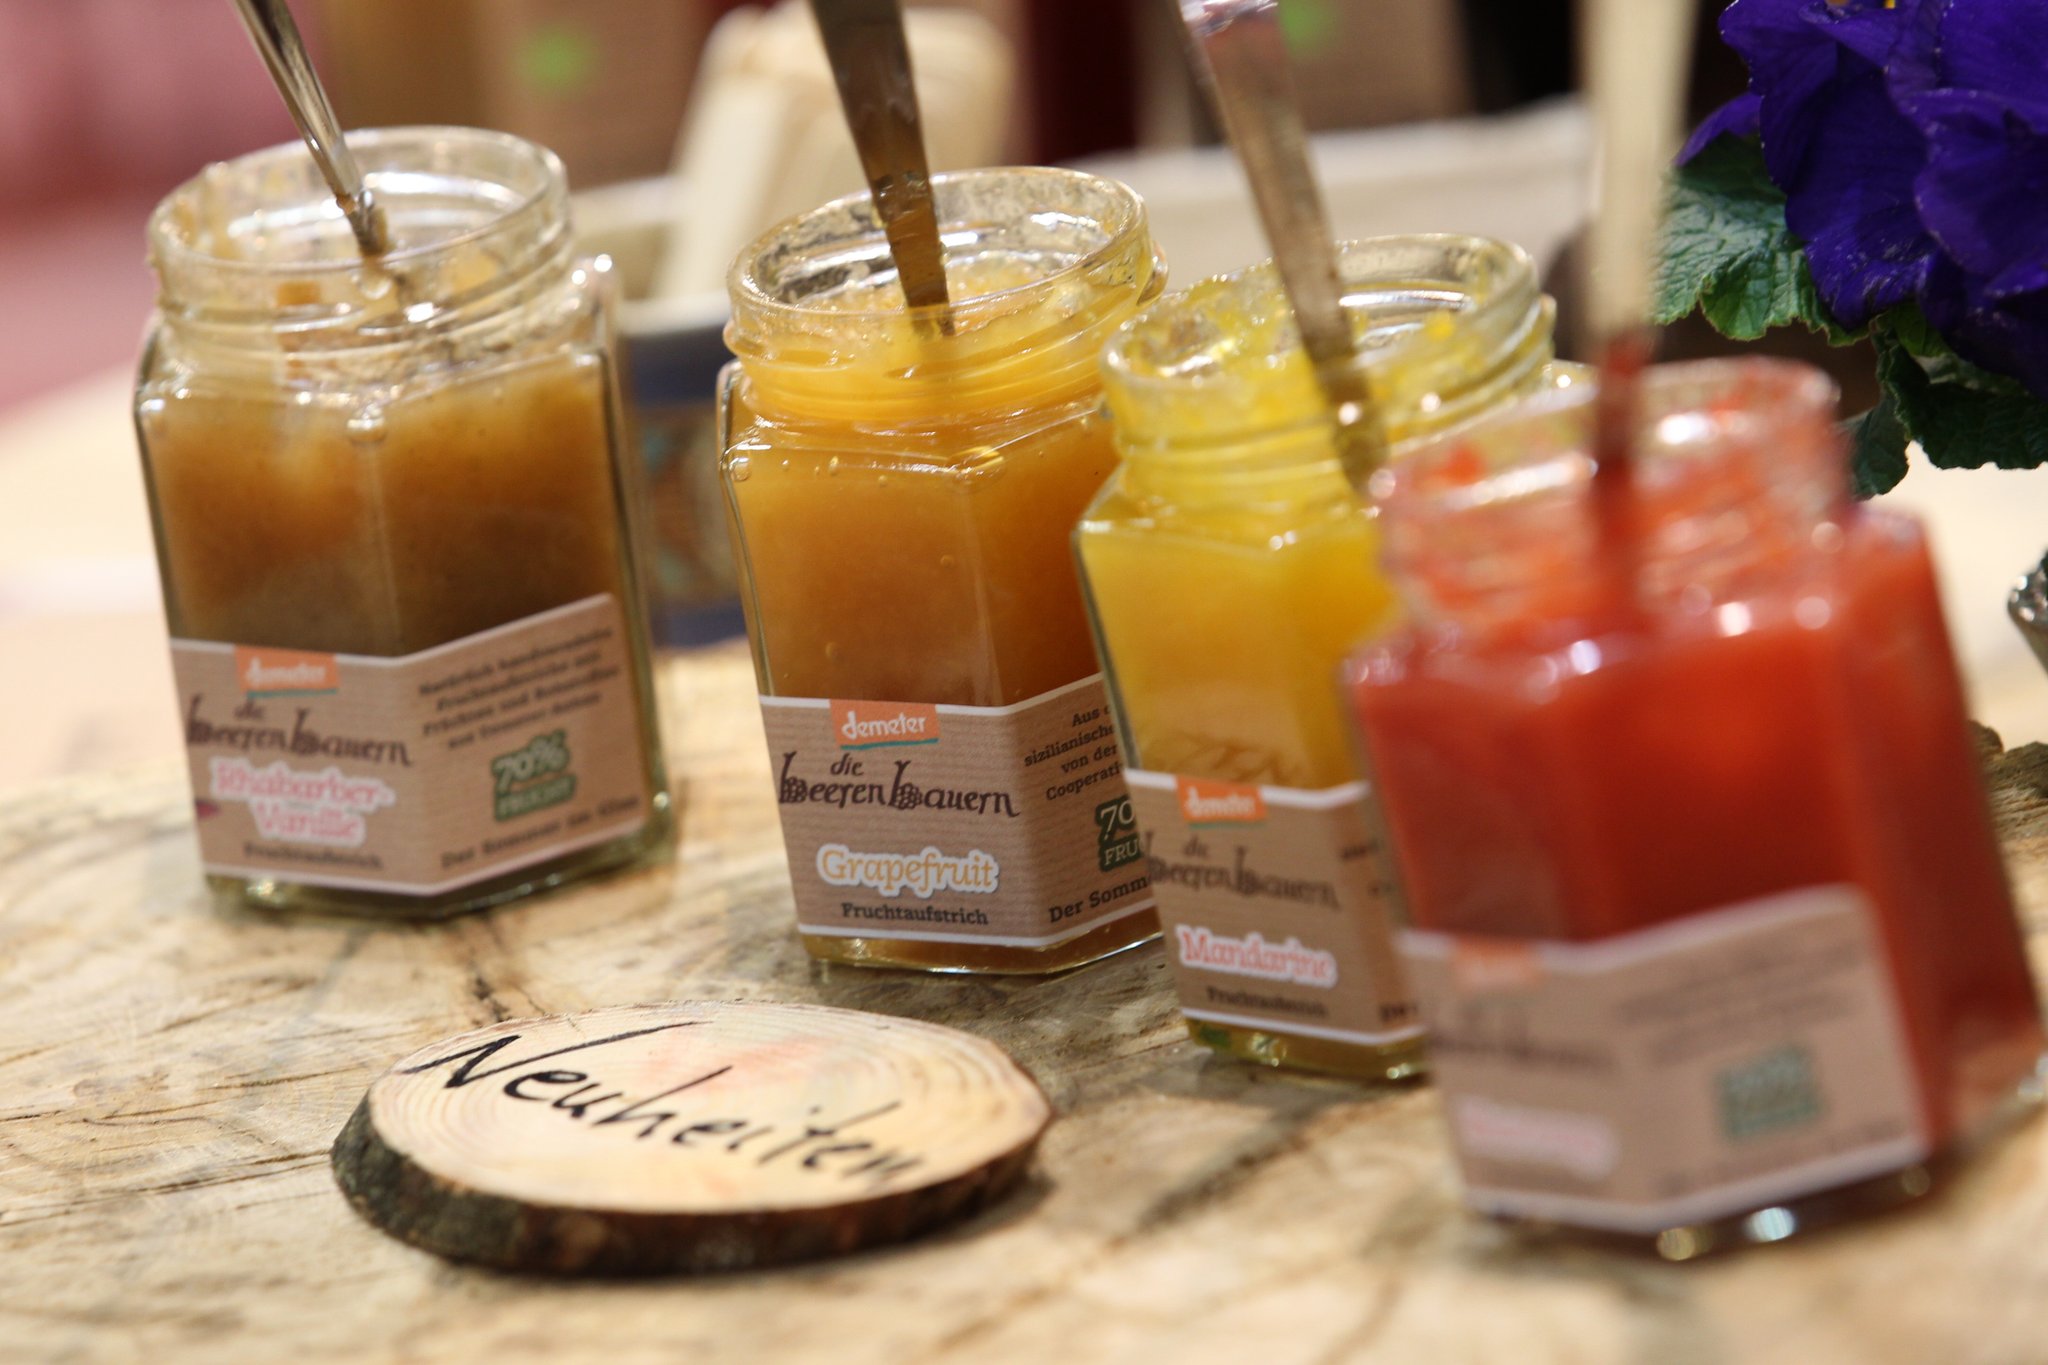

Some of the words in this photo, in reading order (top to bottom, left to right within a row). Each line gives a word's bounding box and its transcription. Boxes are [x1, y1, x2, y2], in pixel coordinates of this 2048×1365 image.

[840, 710, 927, 740] demeter
[1071, 708, 1101, 728] Aus
[494, 733, 568, 794] 70%
[830, 752, 864, 777] die
[1061, 755, 1089, 774] von
[1093, 744, 1117, 762] der
[1045, 761, 1122, 801] Cooperati
[820, 848, 996, 894] Grapefruit
[841, 902, 989, 926] Fruchtaufstrich
[1048, 898, 1084, 924] Der
[1180, 928, 1334, 983] Mandarine
[402, 1020, 924, 1181] Neuheiten
